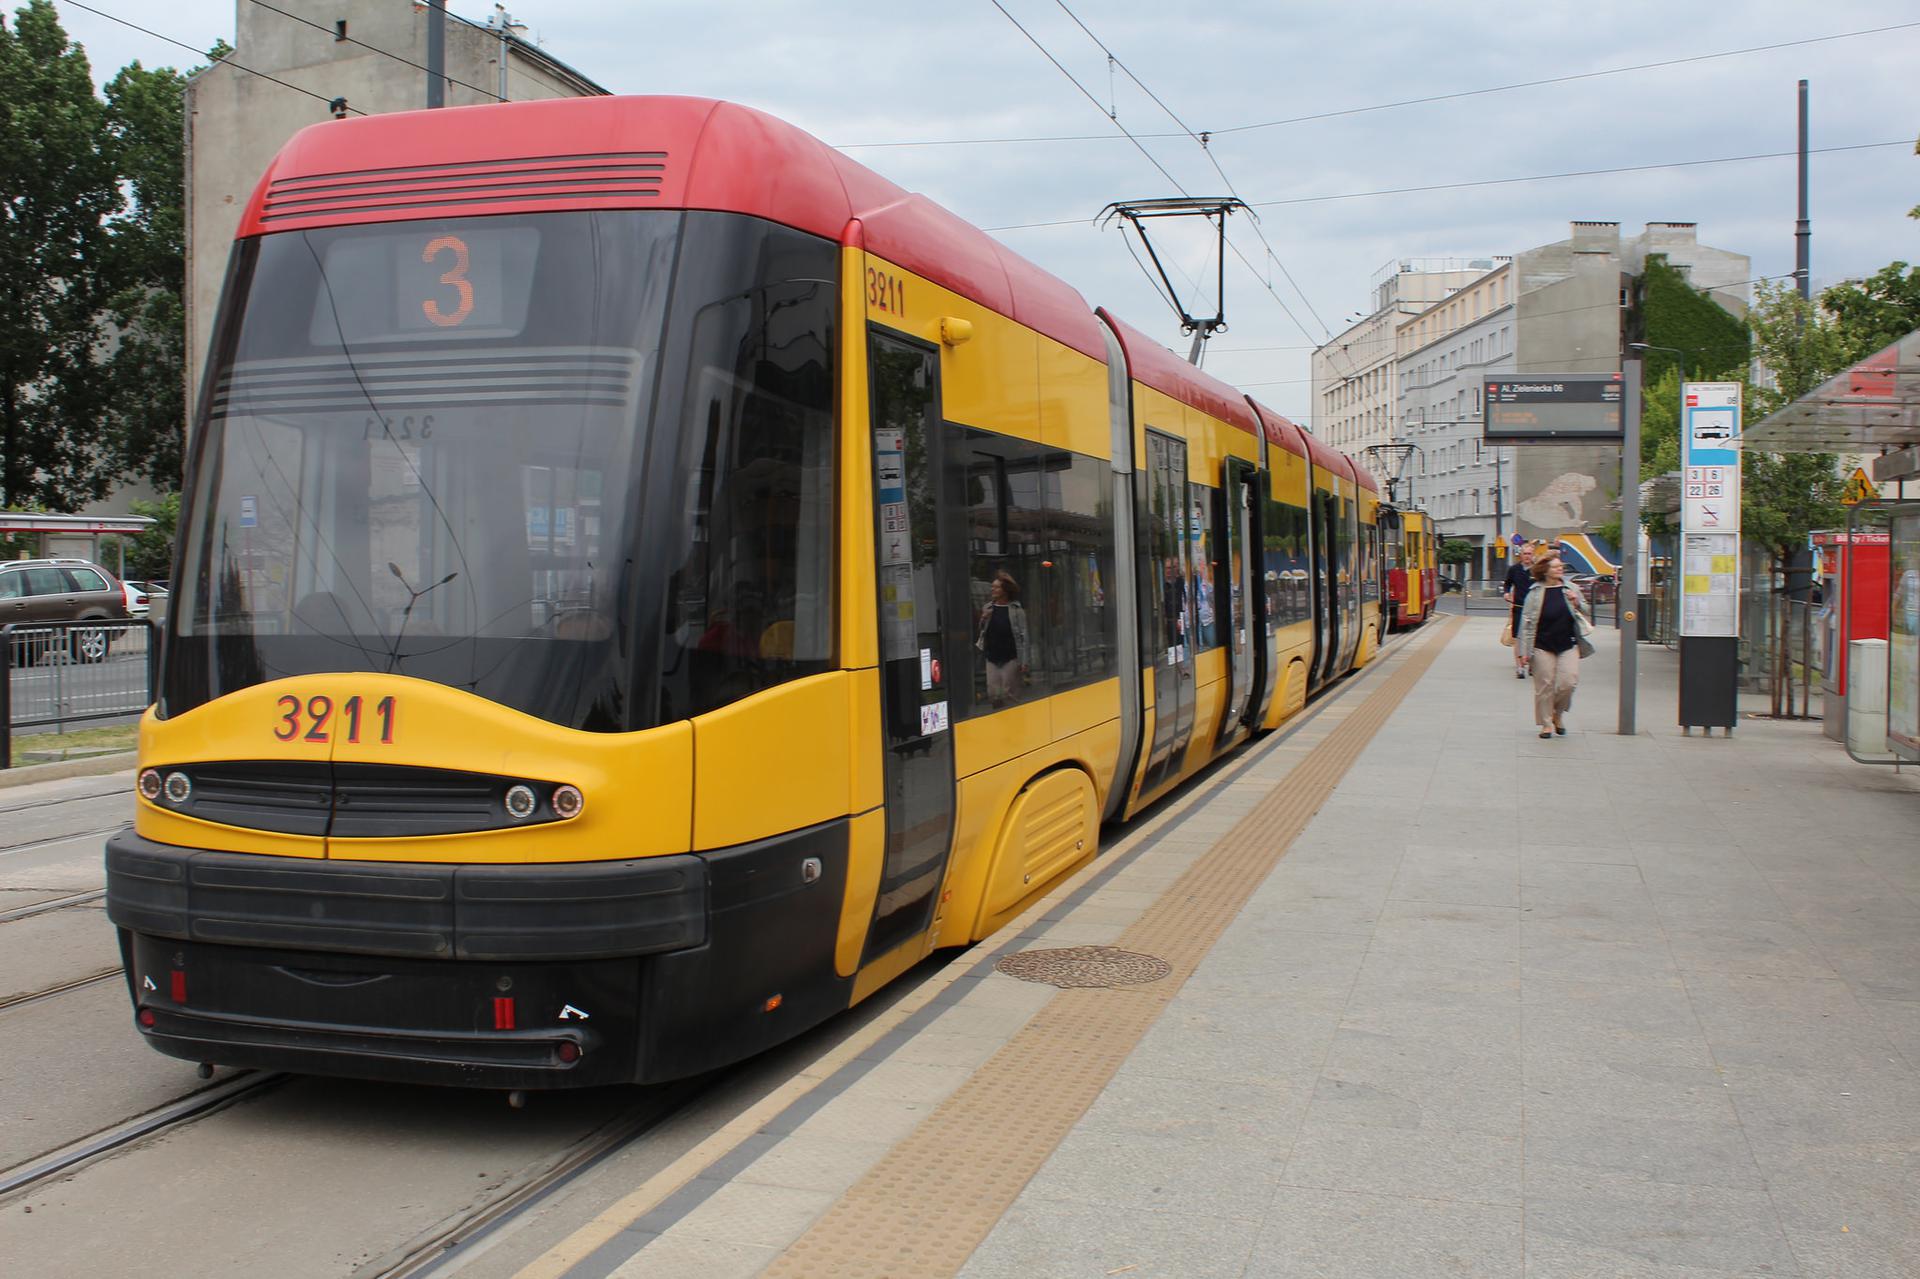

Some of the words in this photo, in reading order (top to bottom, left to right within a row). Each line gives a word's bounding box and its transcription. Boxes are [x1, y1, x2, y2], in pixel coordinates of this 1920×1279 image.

[422, 236, 474, 327] 3
[867, 267, 904, 318] 3211
[1689, 486, 1701, 496] 22
[1708, 486, 1720, 495] 26
[1691, 470, 1698, 480] 3
[273, 695, 396, 744] 3211
